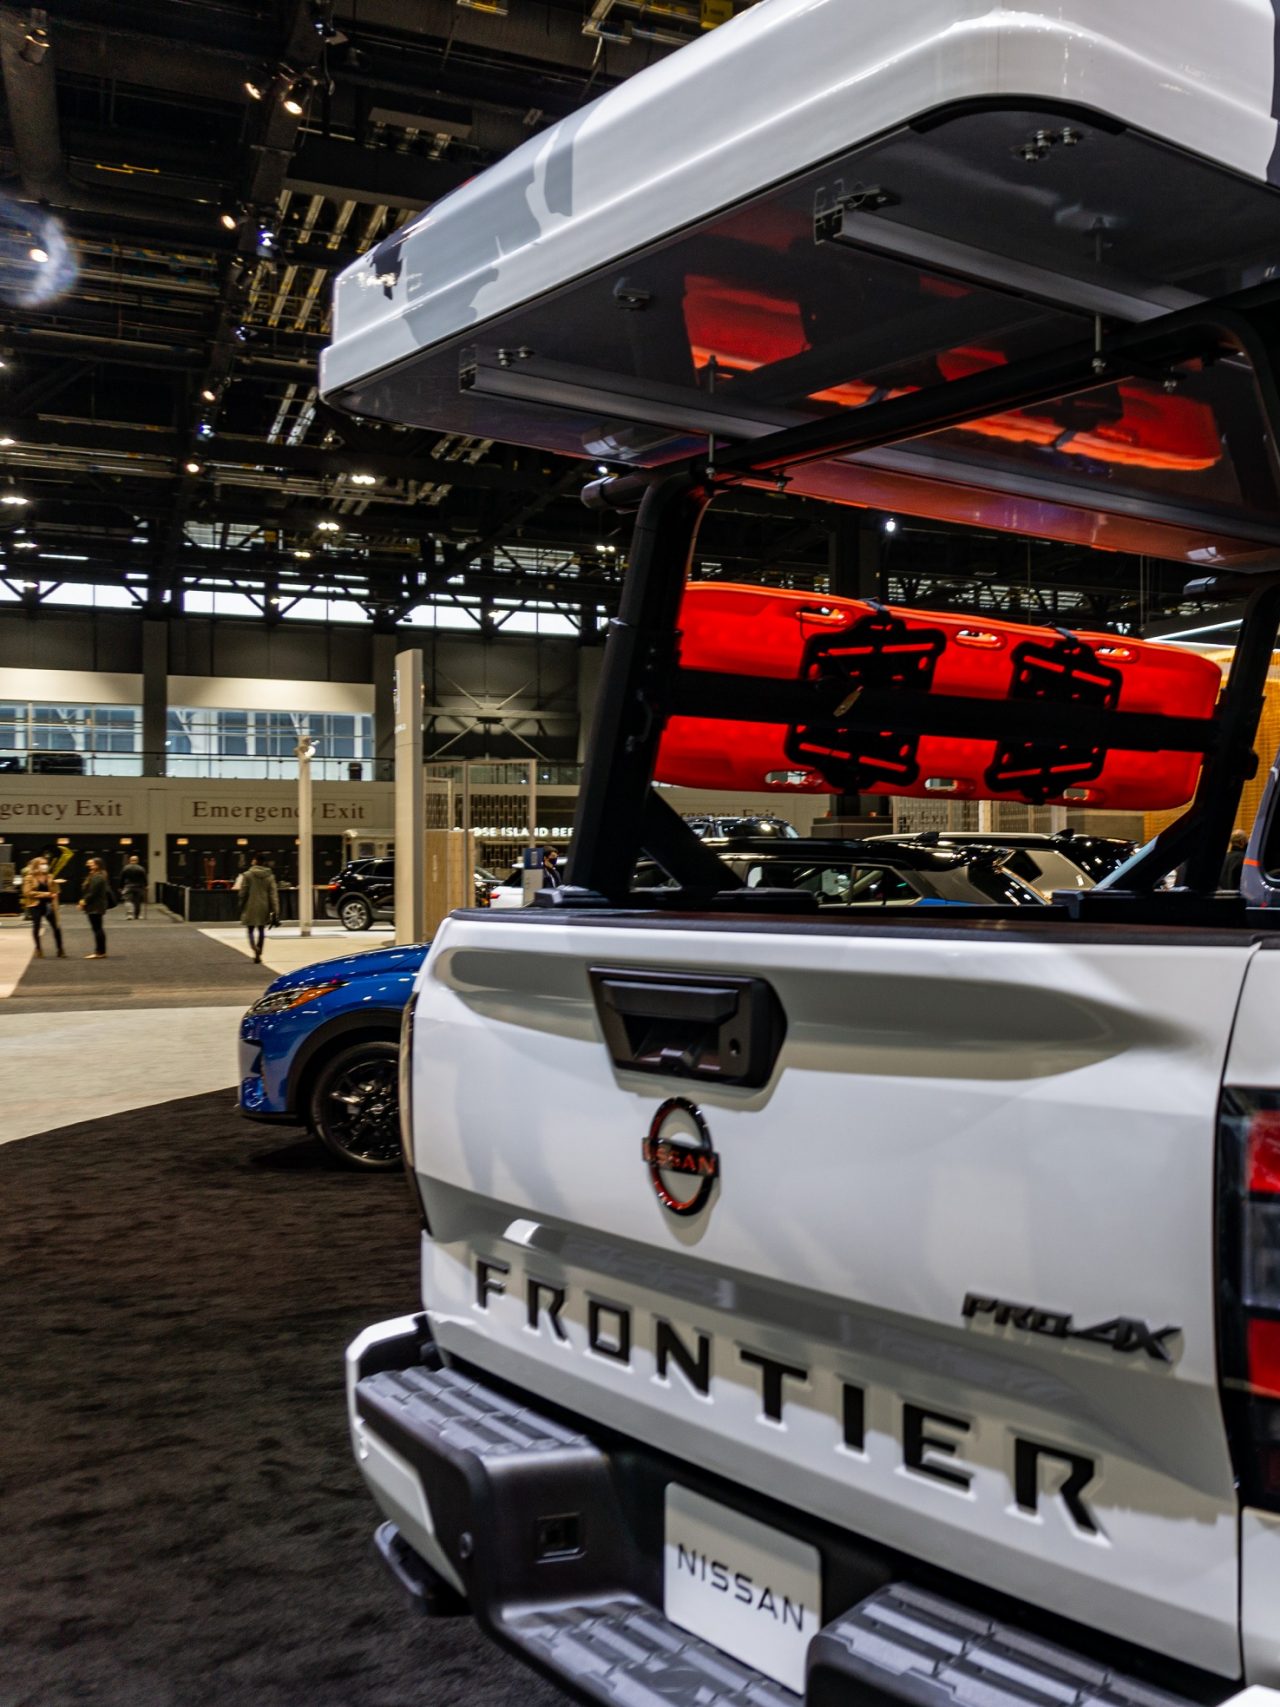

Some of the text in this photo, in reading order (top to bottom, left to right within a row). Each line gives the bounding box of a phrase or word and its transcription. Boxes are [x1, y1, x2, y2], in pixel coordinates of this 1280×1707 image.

[74, 800, 123, 816] Exit
[192, 801, 365, 822] Emergen Exit
[962, 1291, 1182, 1364] PRO-4X
[475, 1260, 1102, 1537] FRONTIER
[678, 1543, 804, 1632] NISSAN
